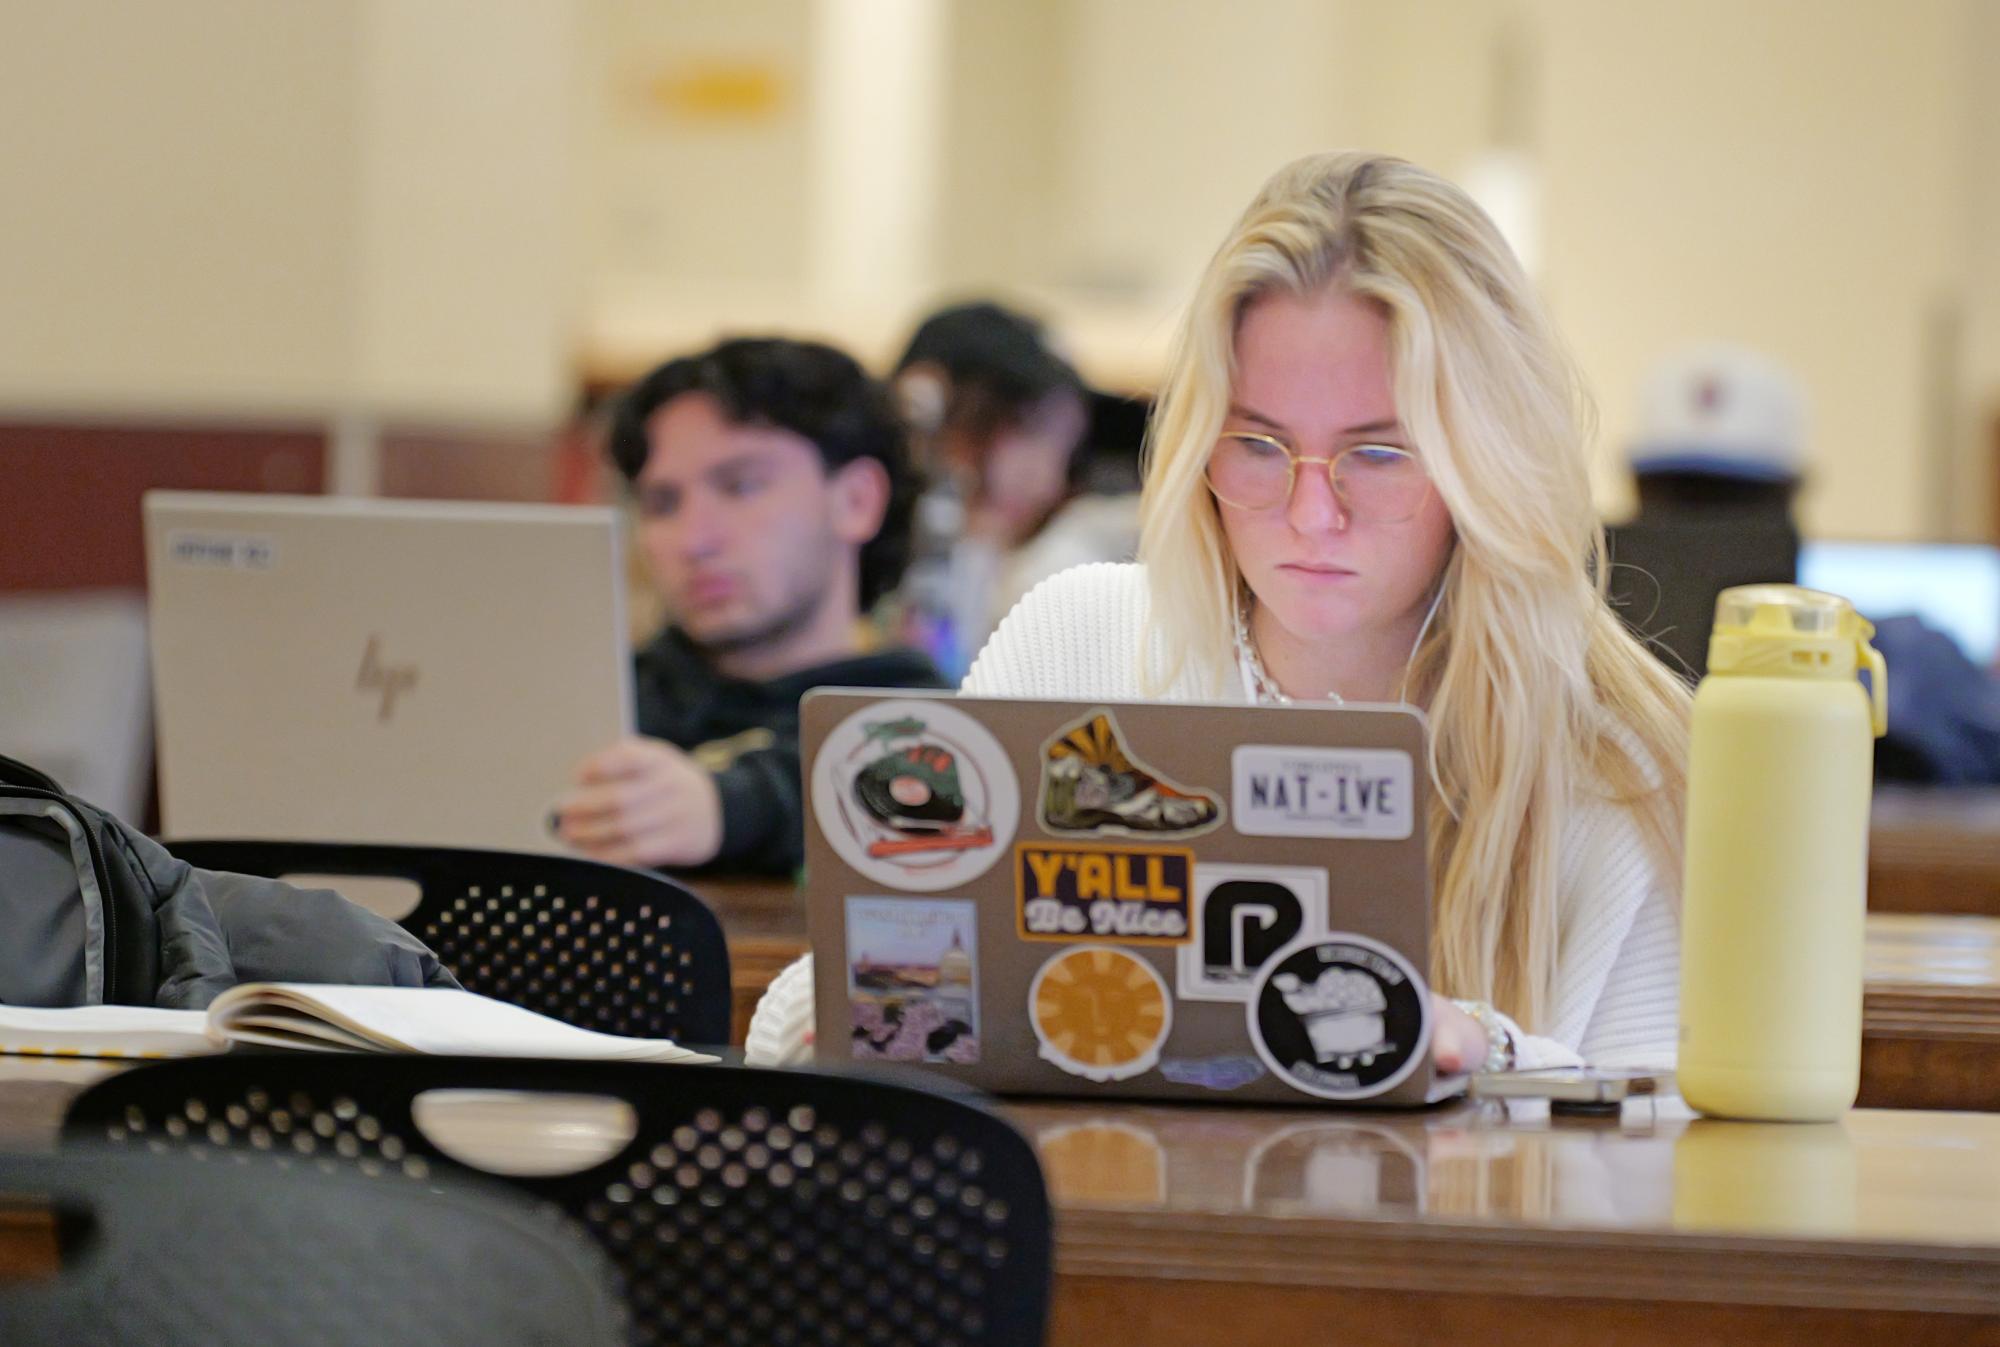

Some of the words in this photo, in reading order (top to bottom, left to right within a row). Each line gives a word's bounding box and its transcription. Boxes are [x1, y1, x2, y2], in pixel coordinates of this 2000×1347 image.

[1027, 852, 1182, 902] Y'ALL
[1025, 898, 1087, 934] Be
[1089, 899, 1186, 937] Nice
